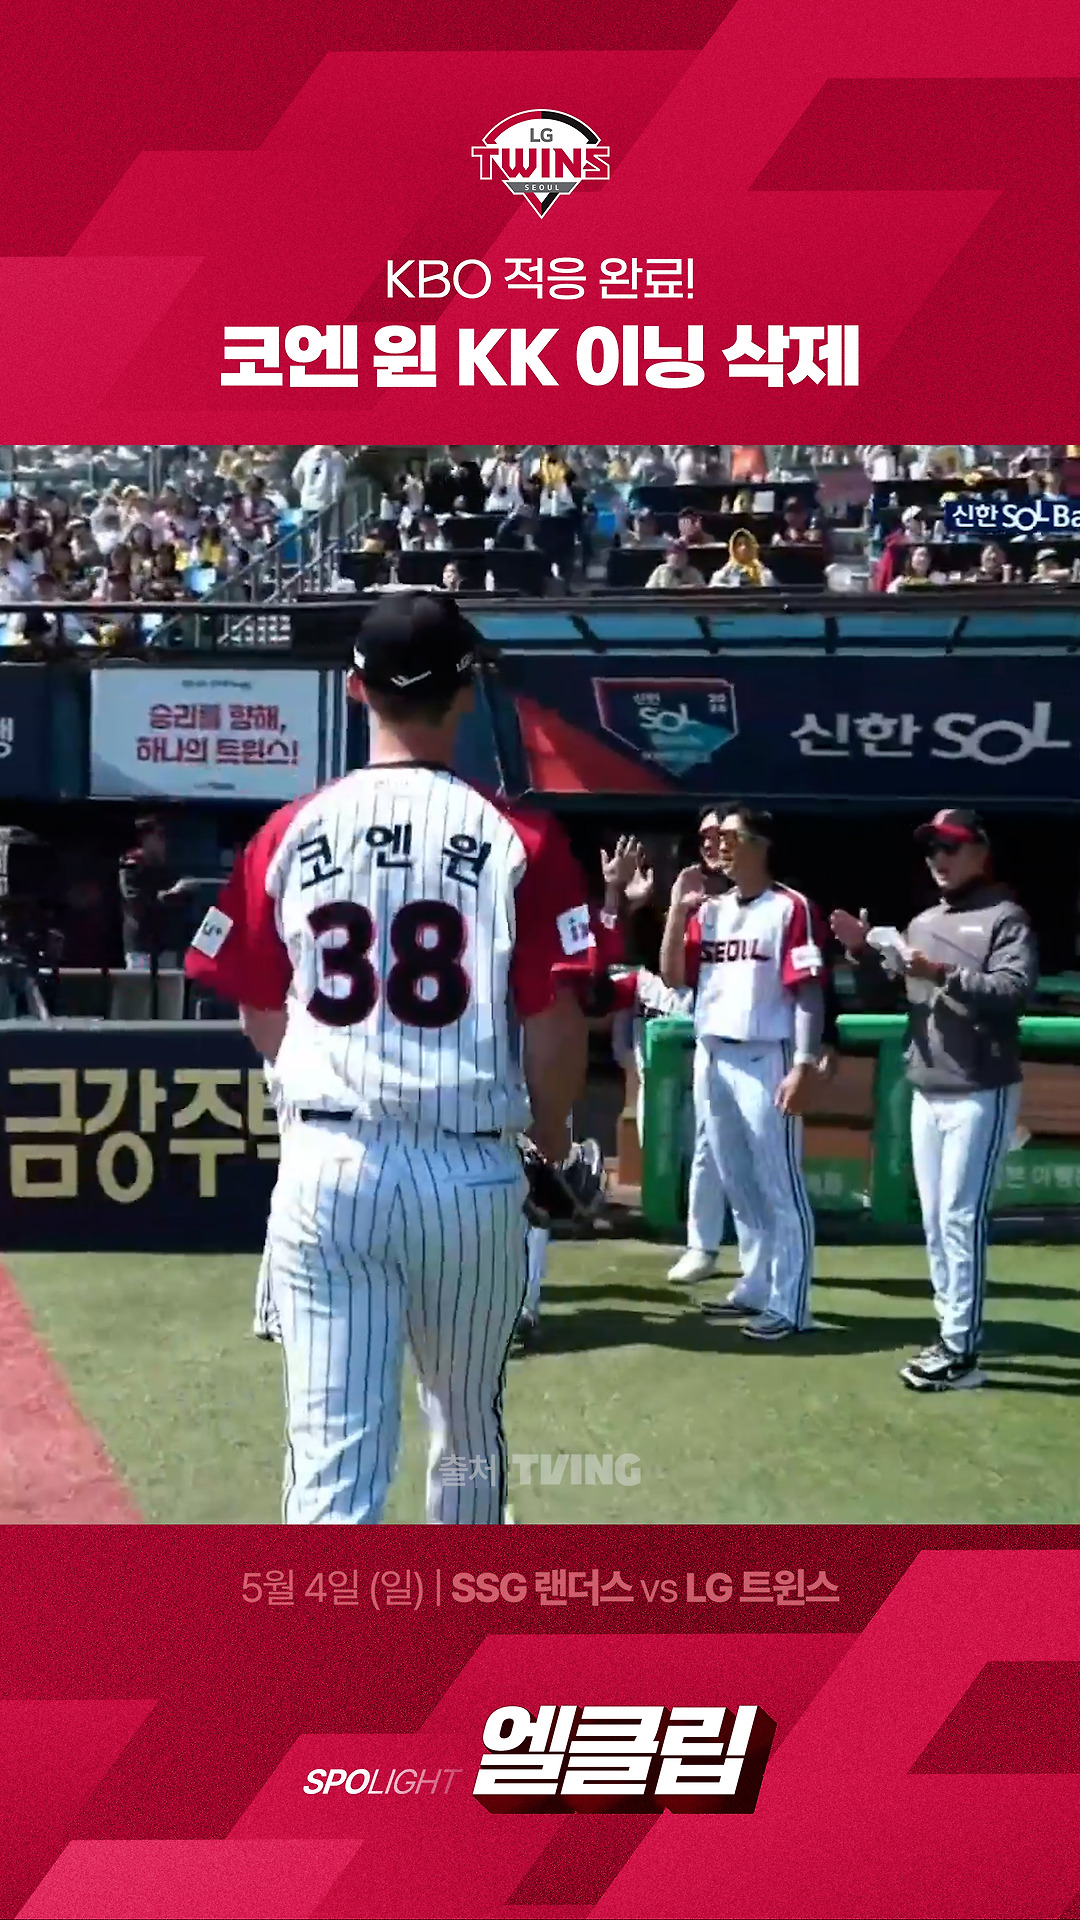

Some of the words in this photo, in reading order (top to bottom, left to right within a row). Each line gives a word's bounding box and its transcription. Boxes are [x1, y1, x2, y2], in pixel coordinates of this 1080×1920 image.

[952, 504, 998, 527] 신한
[215, 736, 299, 765] 트윈스!
[791, 711, 923, 758] 신한
[306, 900, 471, 1029] 38
